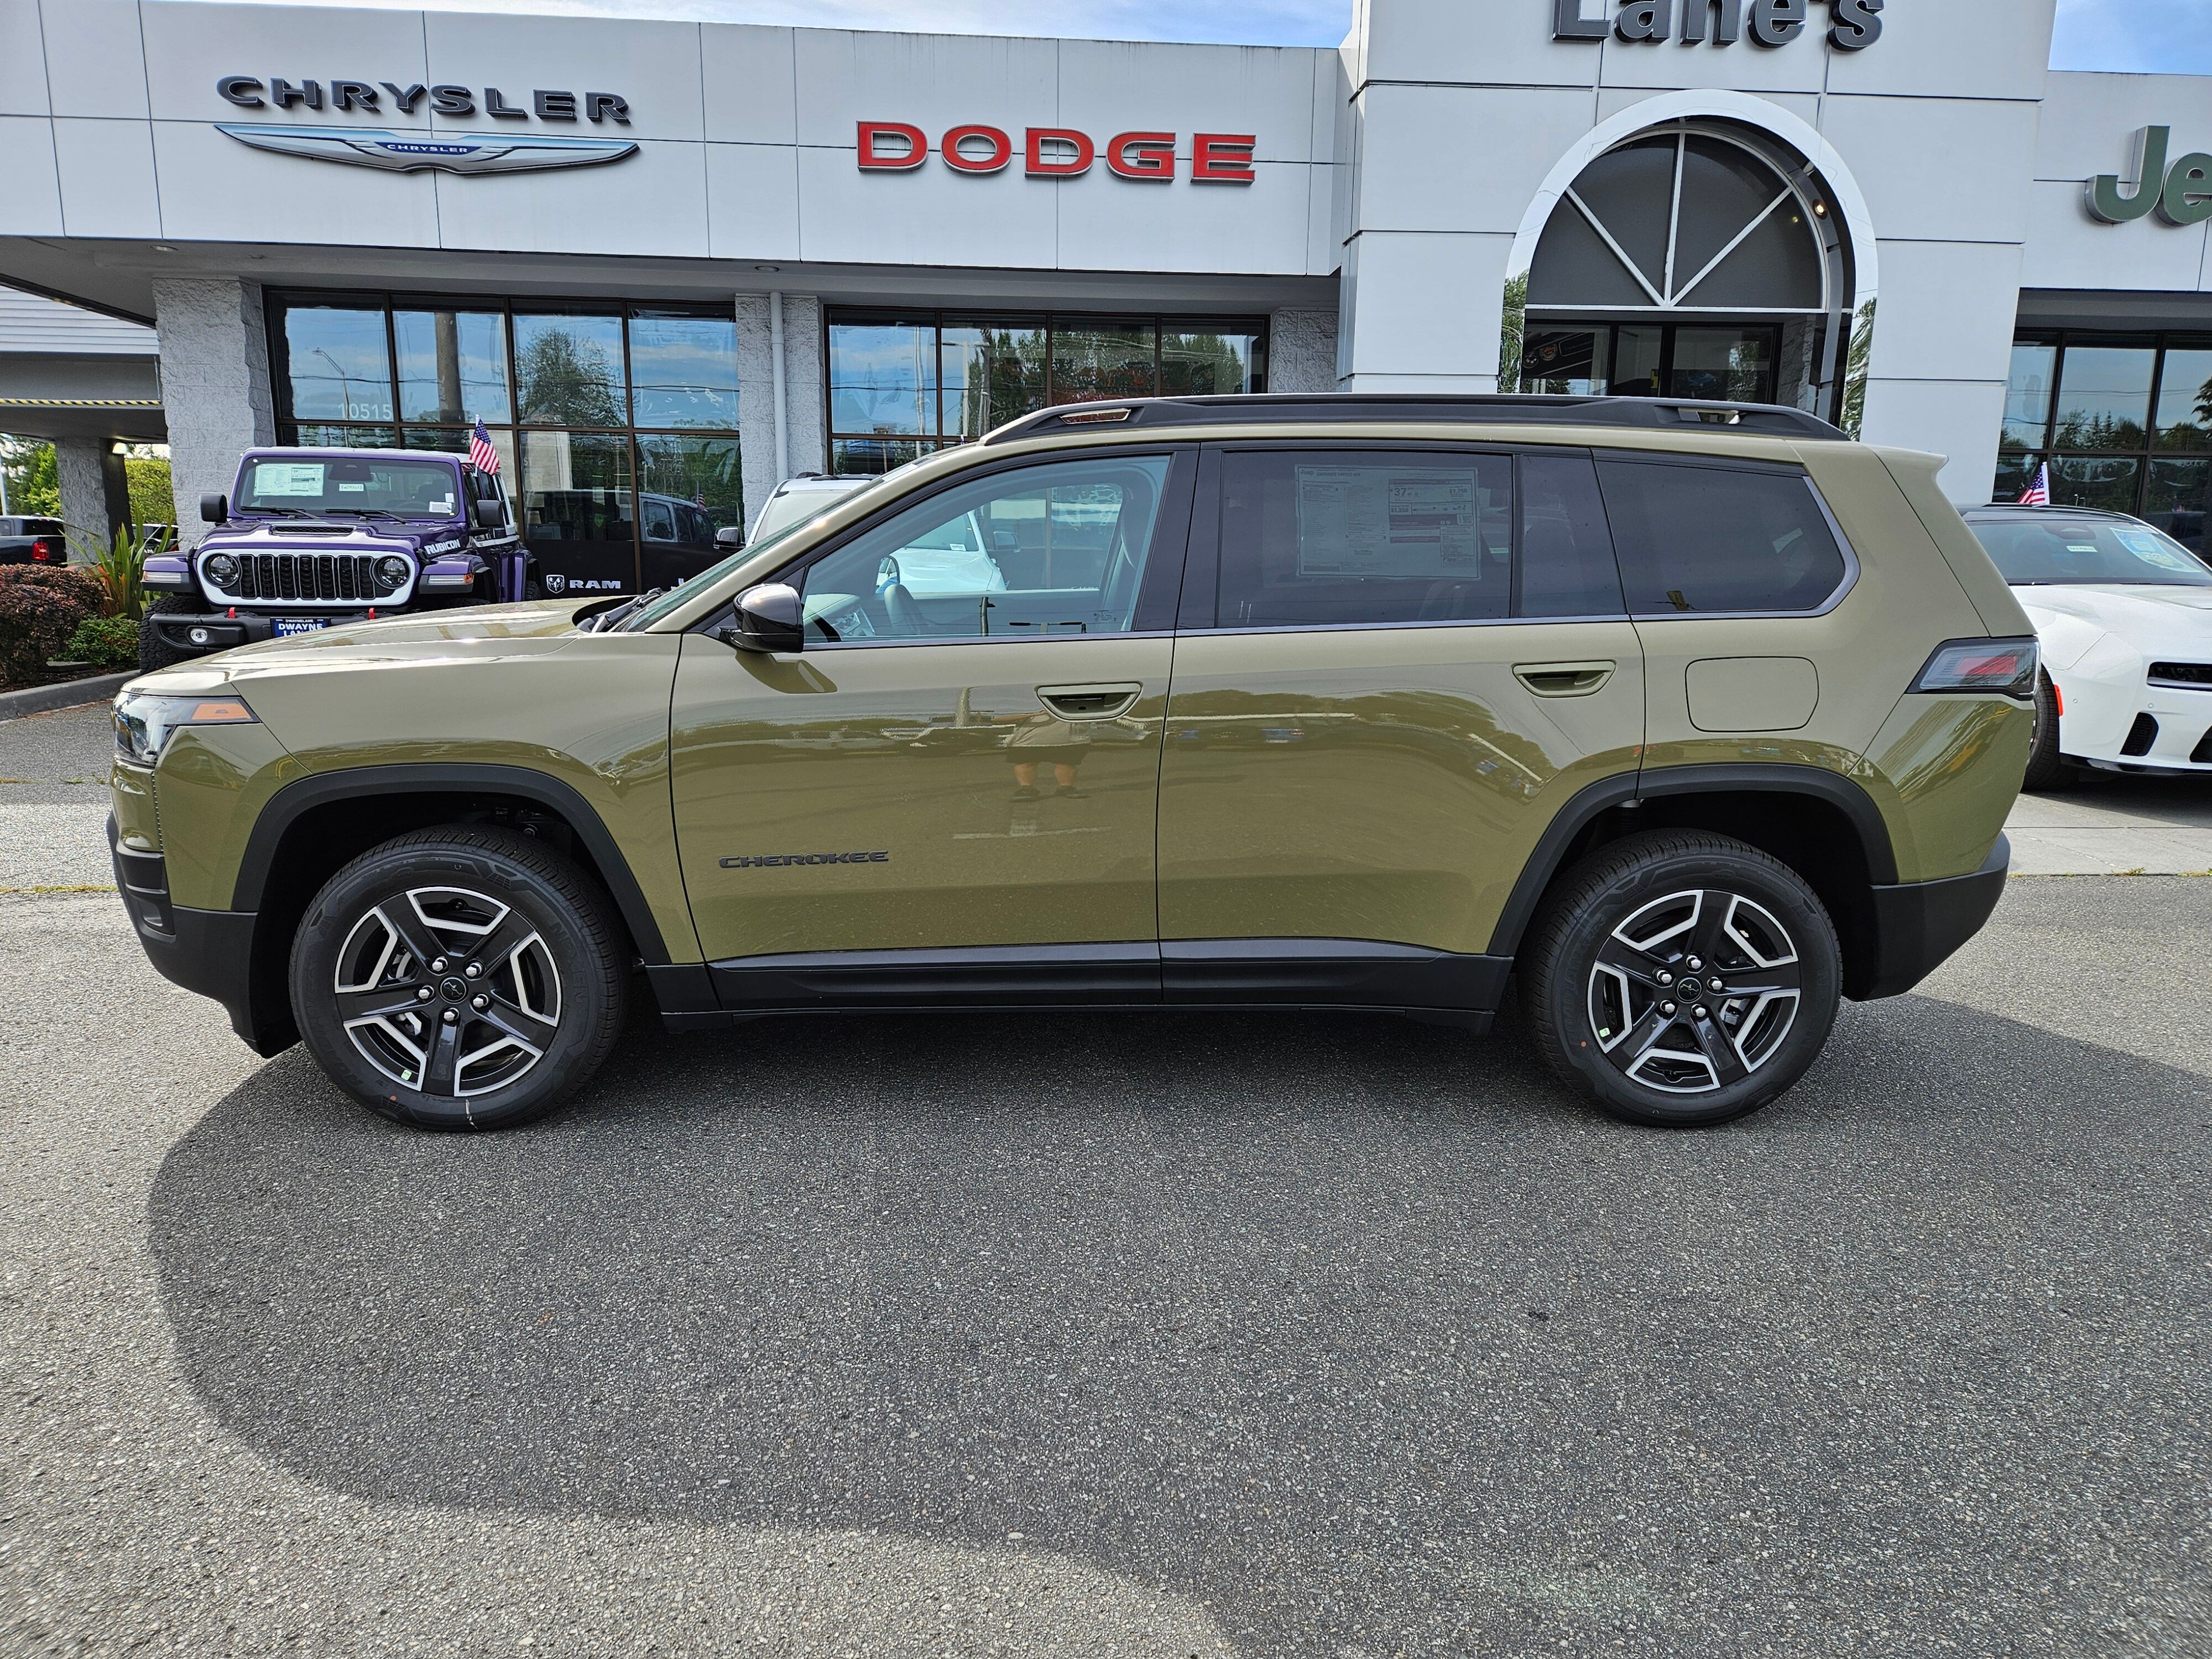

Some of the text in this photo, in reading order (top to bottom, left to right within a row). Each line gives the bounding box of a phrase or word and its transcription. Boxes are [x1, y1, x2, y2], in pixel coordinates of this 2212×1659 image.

[1553, 0, 1884, 51] Lanes
[216, 76, 631, 124] CHRYSLER
[387, 144, 468, 154] CHRYSLER
[857, 121, 1256, 185] DODGE
[338, 403, 393, 420] 10515
[1394, 487, 1406, 496] 37
[424, 539, 461, 555] RUBICON
[569, 580, 621, 589] RAM
[278, 623, 323, 632] DWAYNE
[719, 850, 889, 868] CHEROKEE
